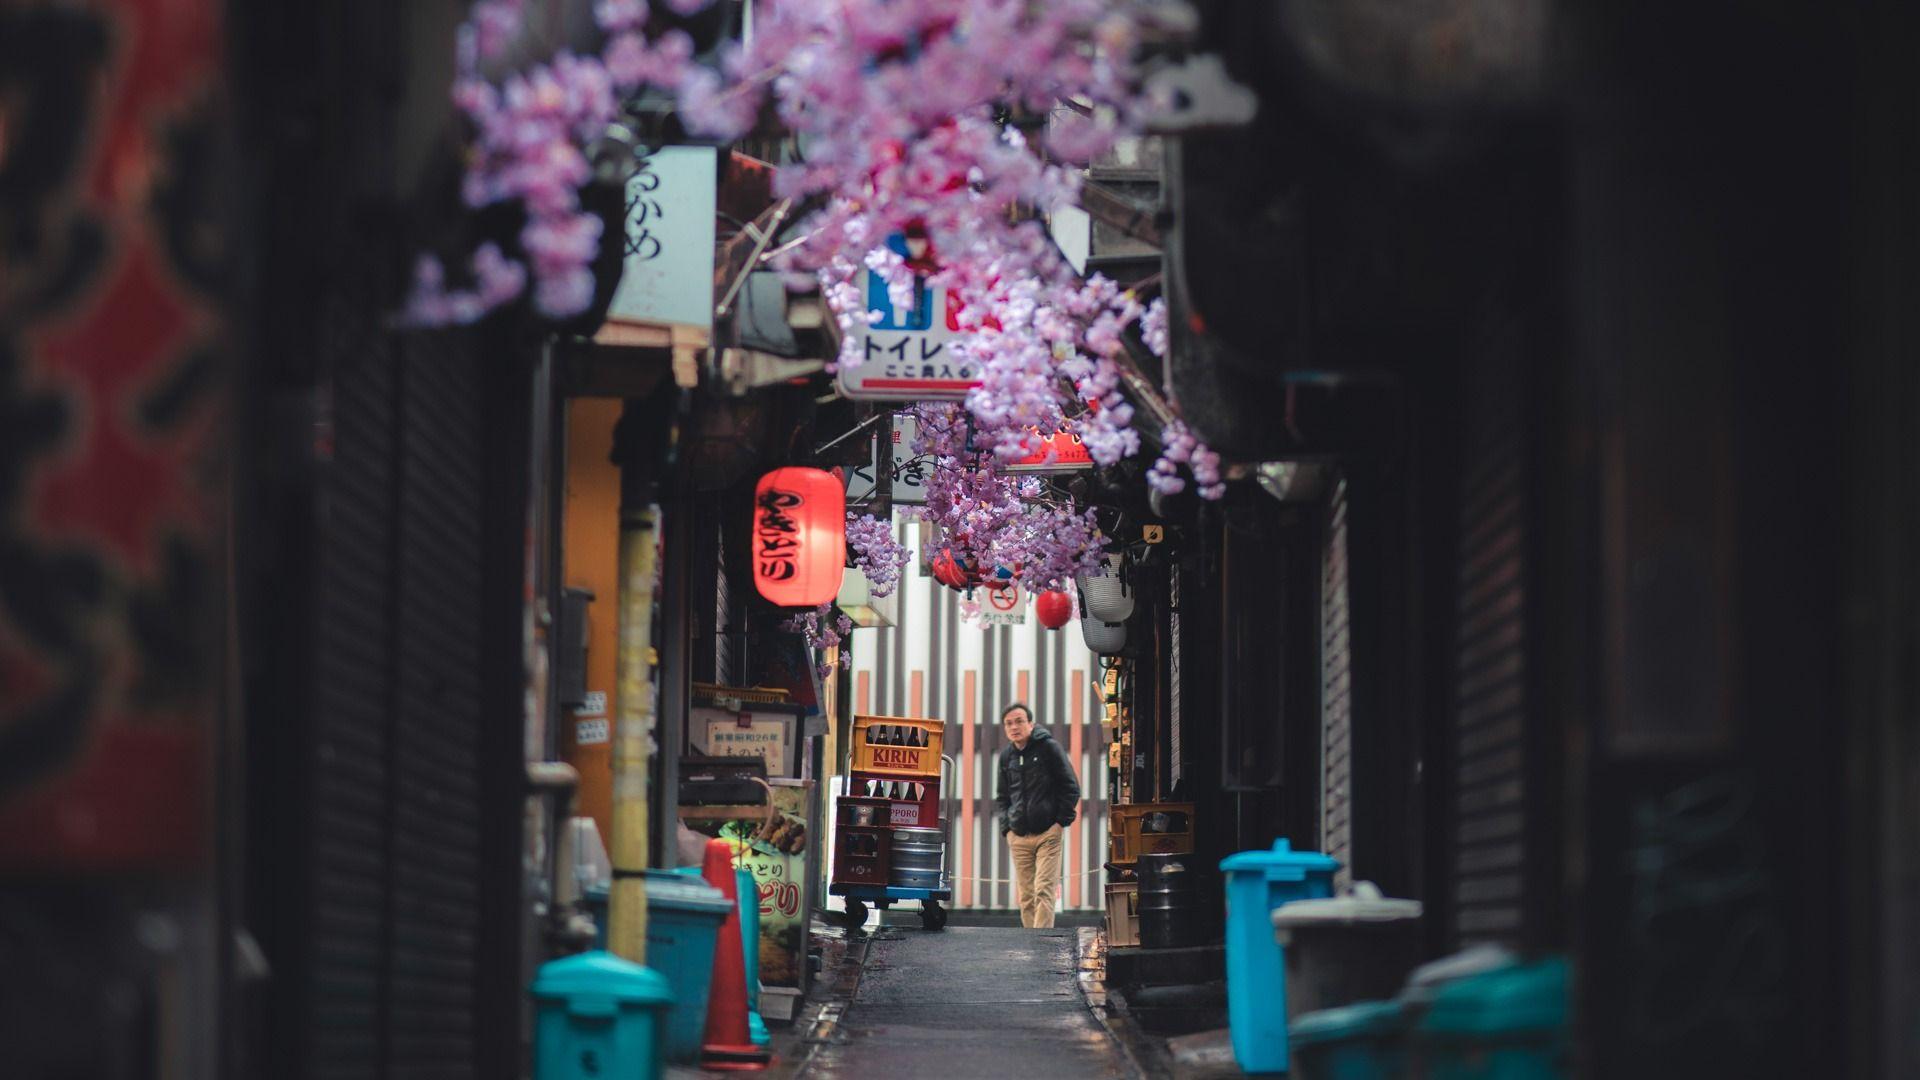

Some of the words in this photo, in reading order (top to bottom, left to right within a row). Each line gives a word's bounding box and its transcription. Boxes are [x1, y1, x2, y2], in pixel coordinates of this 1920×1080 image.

[865, 335, 943, 361] トイレ
[873, 748, 920, 763] KIRIN
